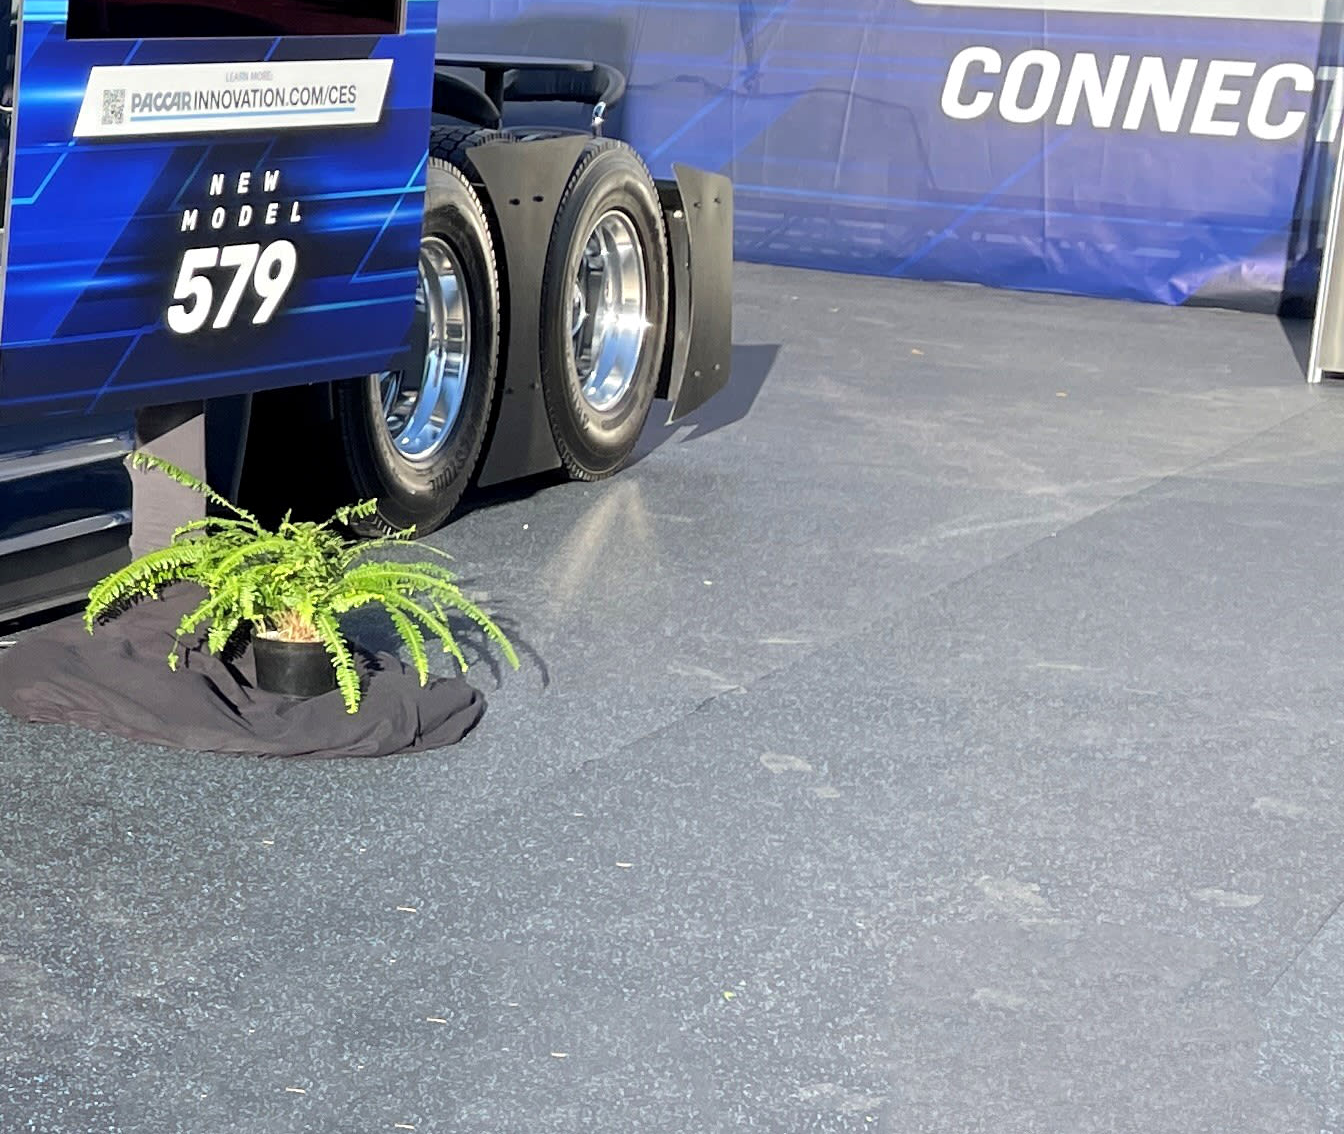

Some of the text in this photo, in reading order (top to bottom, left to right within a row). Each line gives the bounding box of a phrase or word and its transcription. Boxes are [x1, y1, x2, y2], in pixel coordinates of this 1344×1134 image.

[226, 72, 249, 82] LEARN
[209, 170, 280, 196] NEW
[181, 201, 302, 232] MODEL
[168, 239, 297, 334] 579
